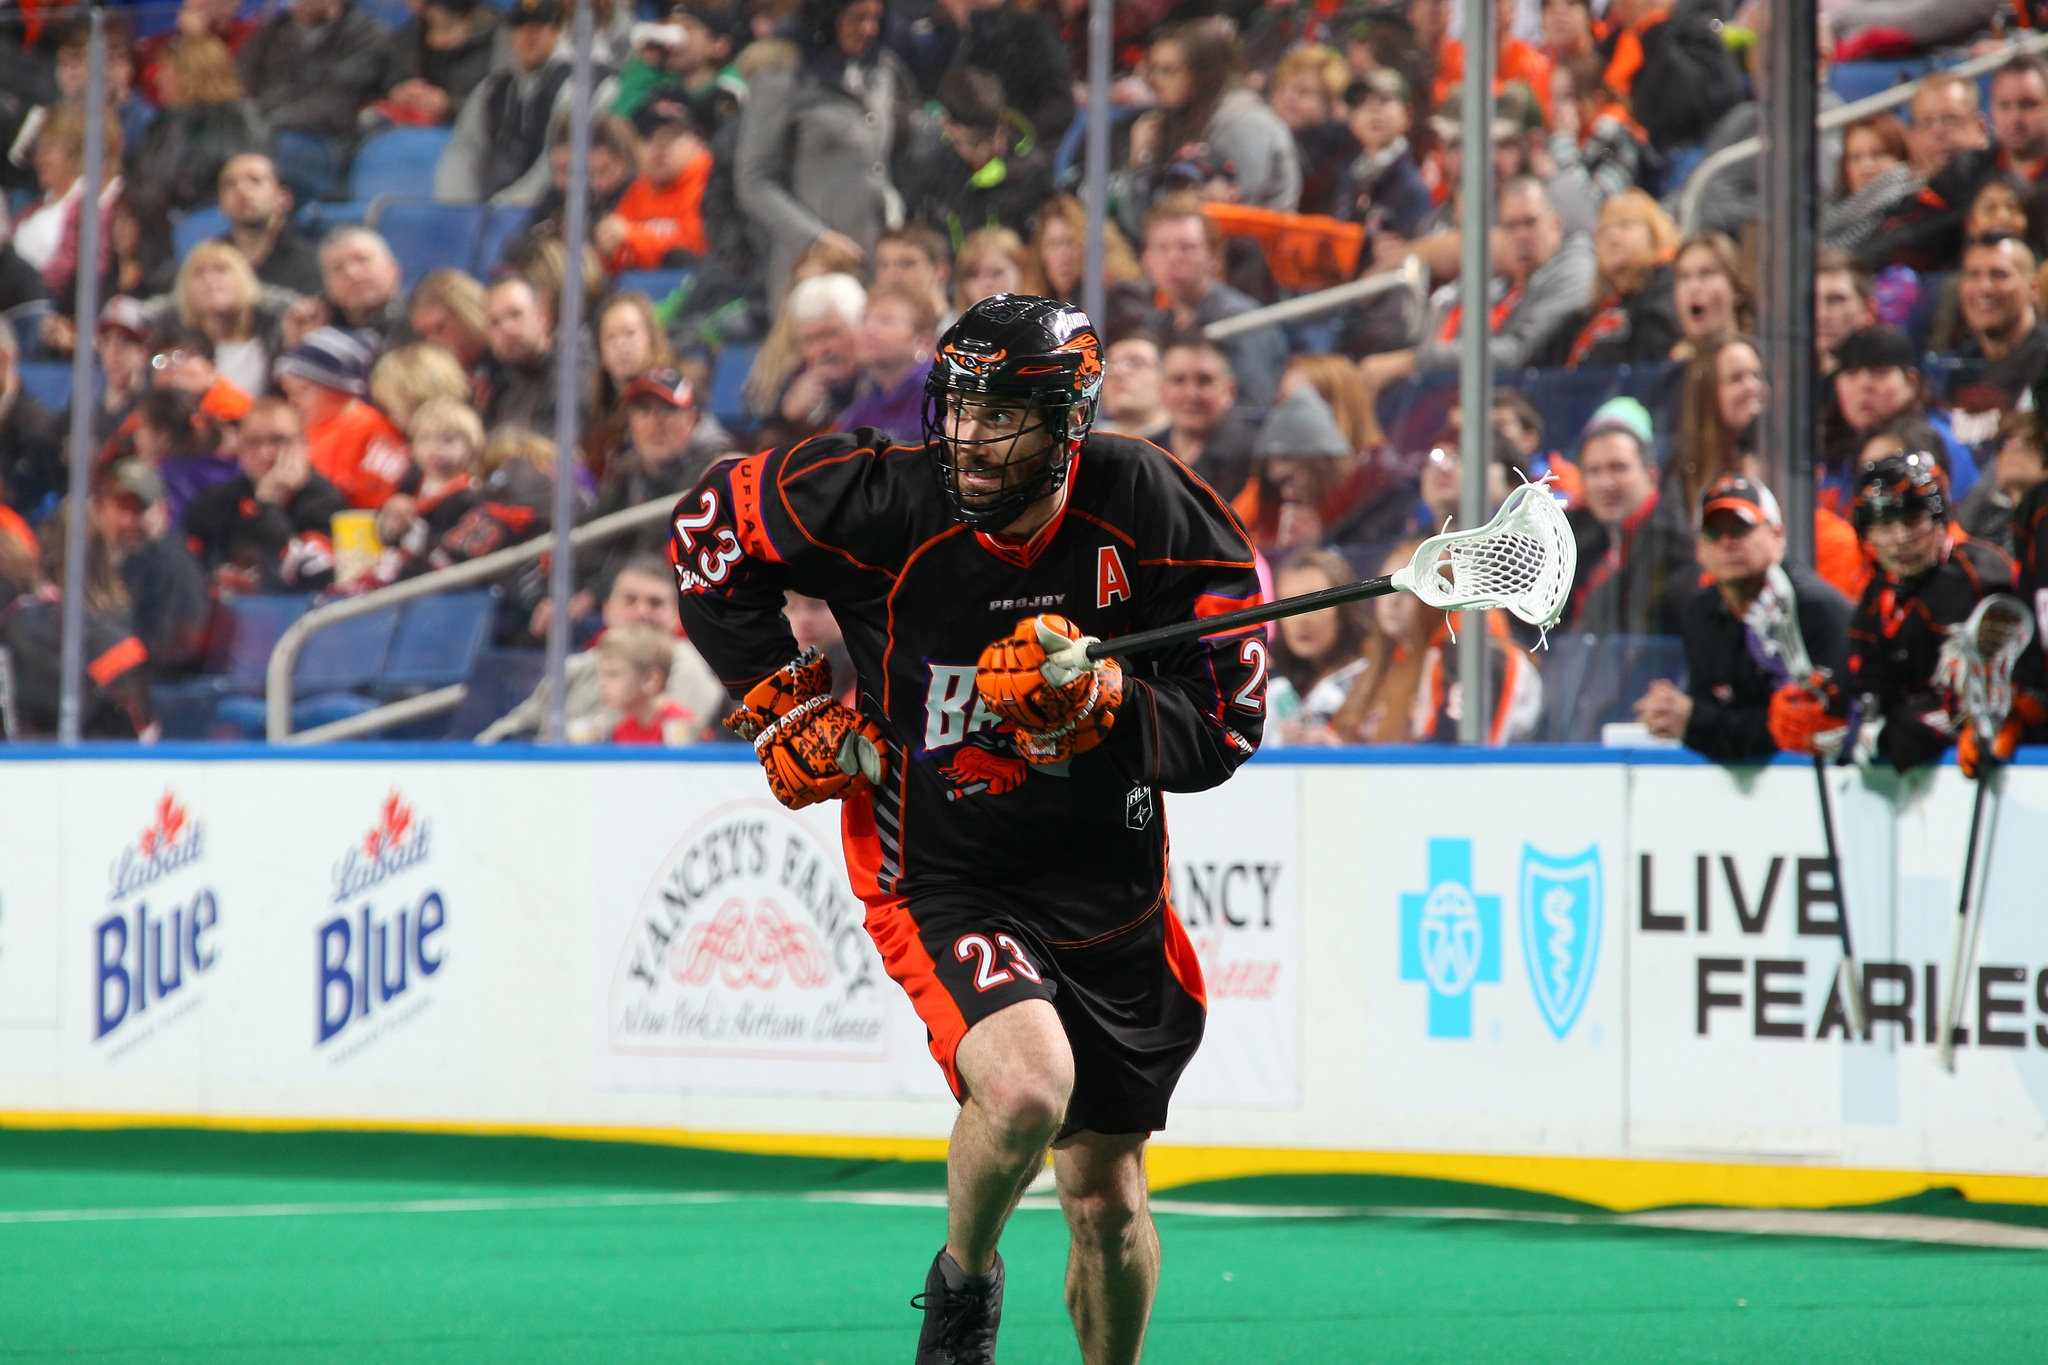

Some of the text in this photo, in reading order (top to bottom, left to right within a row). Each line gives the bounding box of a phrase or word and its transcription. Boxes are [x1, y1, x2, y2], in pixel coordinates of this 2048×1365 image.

[674, 487, 745, 585] 23
[1096, 545, 1132, 609] A
[988, 594, 1066, 611] PROJOY
[1230, 637, 1268, 712] 2
[779, 832, 873, 996] FANCY
[1167, 860, 1281, 929] ANCY
[1639, 853, 1843, 935] LIVE
[91, 887, 218, 1043] Blue
[313, 889, 446, 1047] Blue
[954, 932, 1042, 993] 23
[1696, 956, 2048, 1049] FEARLE
